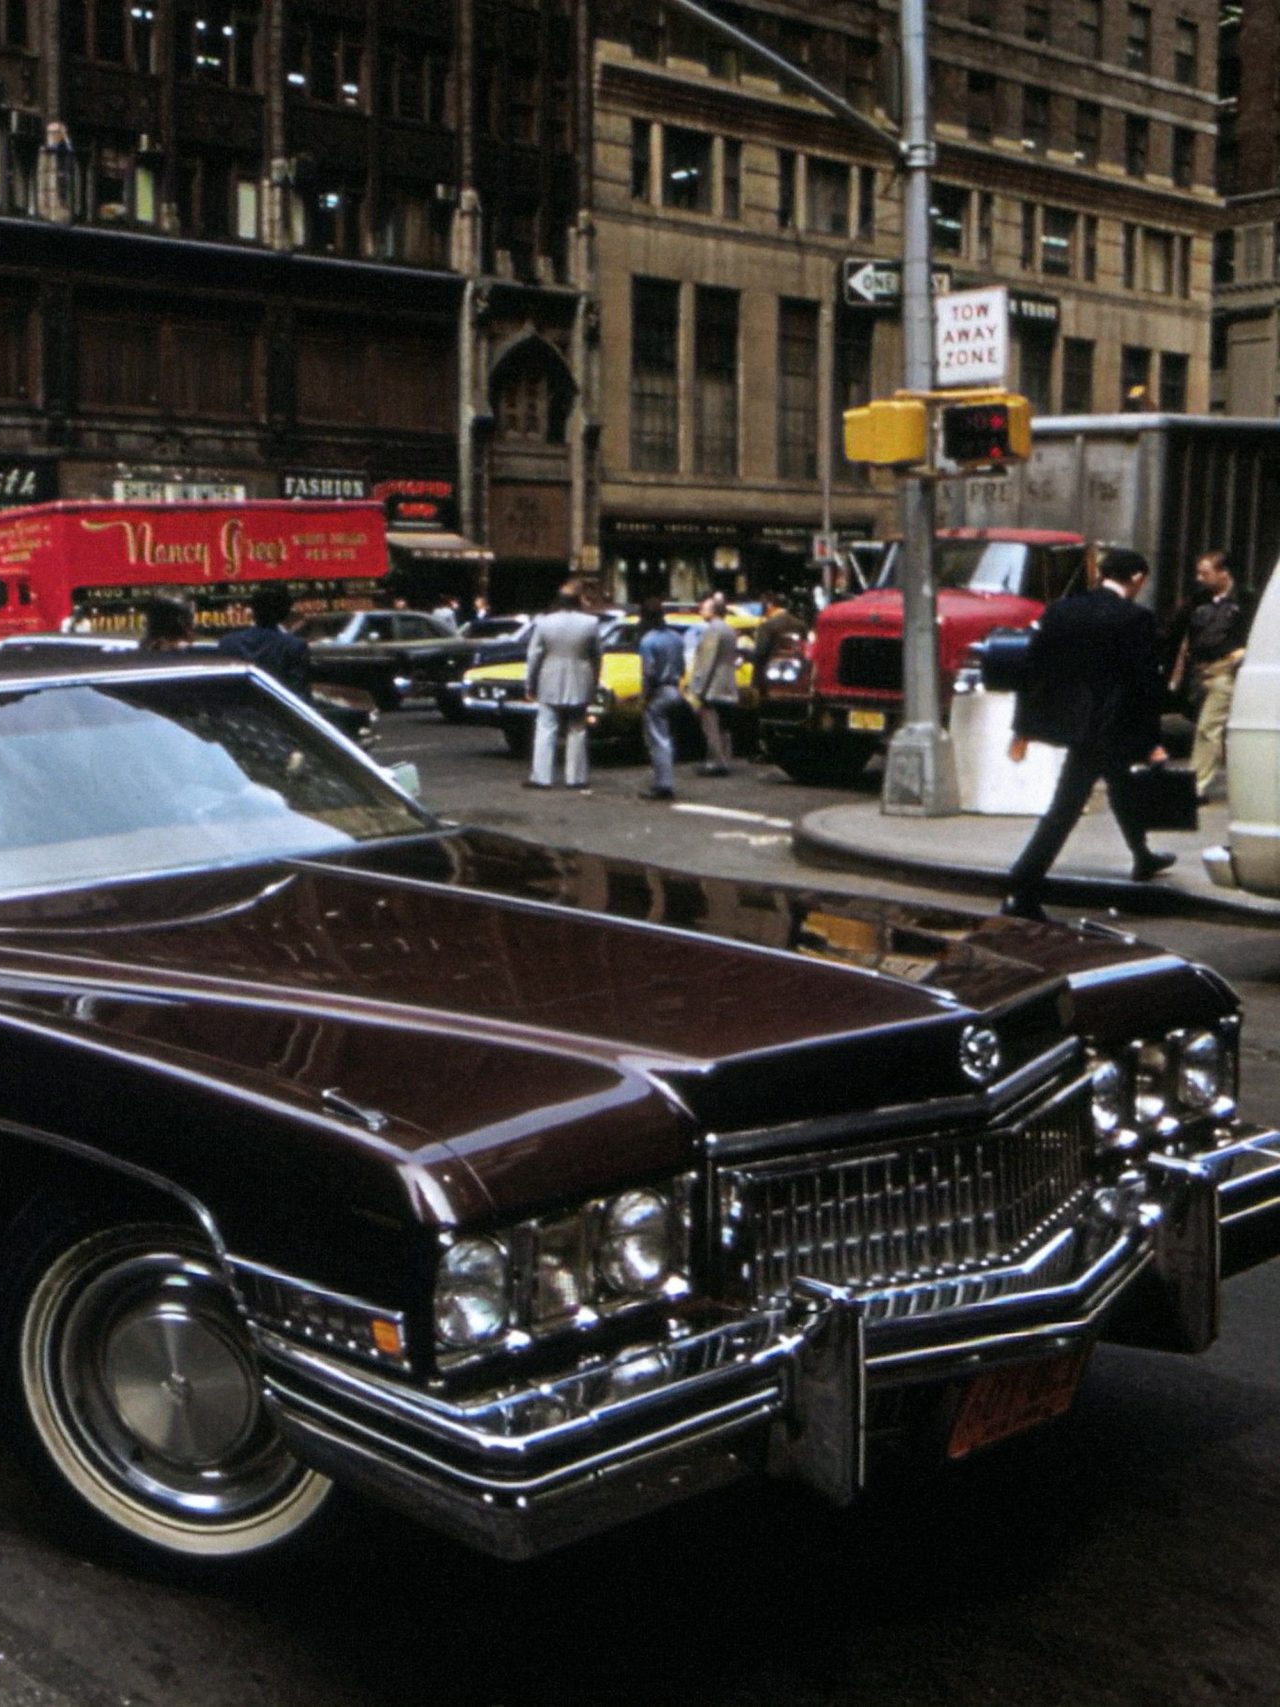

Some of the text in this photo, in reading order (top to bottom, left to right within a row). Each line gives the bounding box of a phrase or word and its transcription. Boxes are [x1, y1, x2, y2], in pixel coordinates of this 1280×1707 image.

[862, 273, 899, 292] ONE
[951, 303, 989, 321] TOW
[943, 326, 998, 344] AWAY
[944, 348, 997, 368] ZONE
[285, 477, 363, 497] FASHION
[81, 519, 211, 577] Nancy
